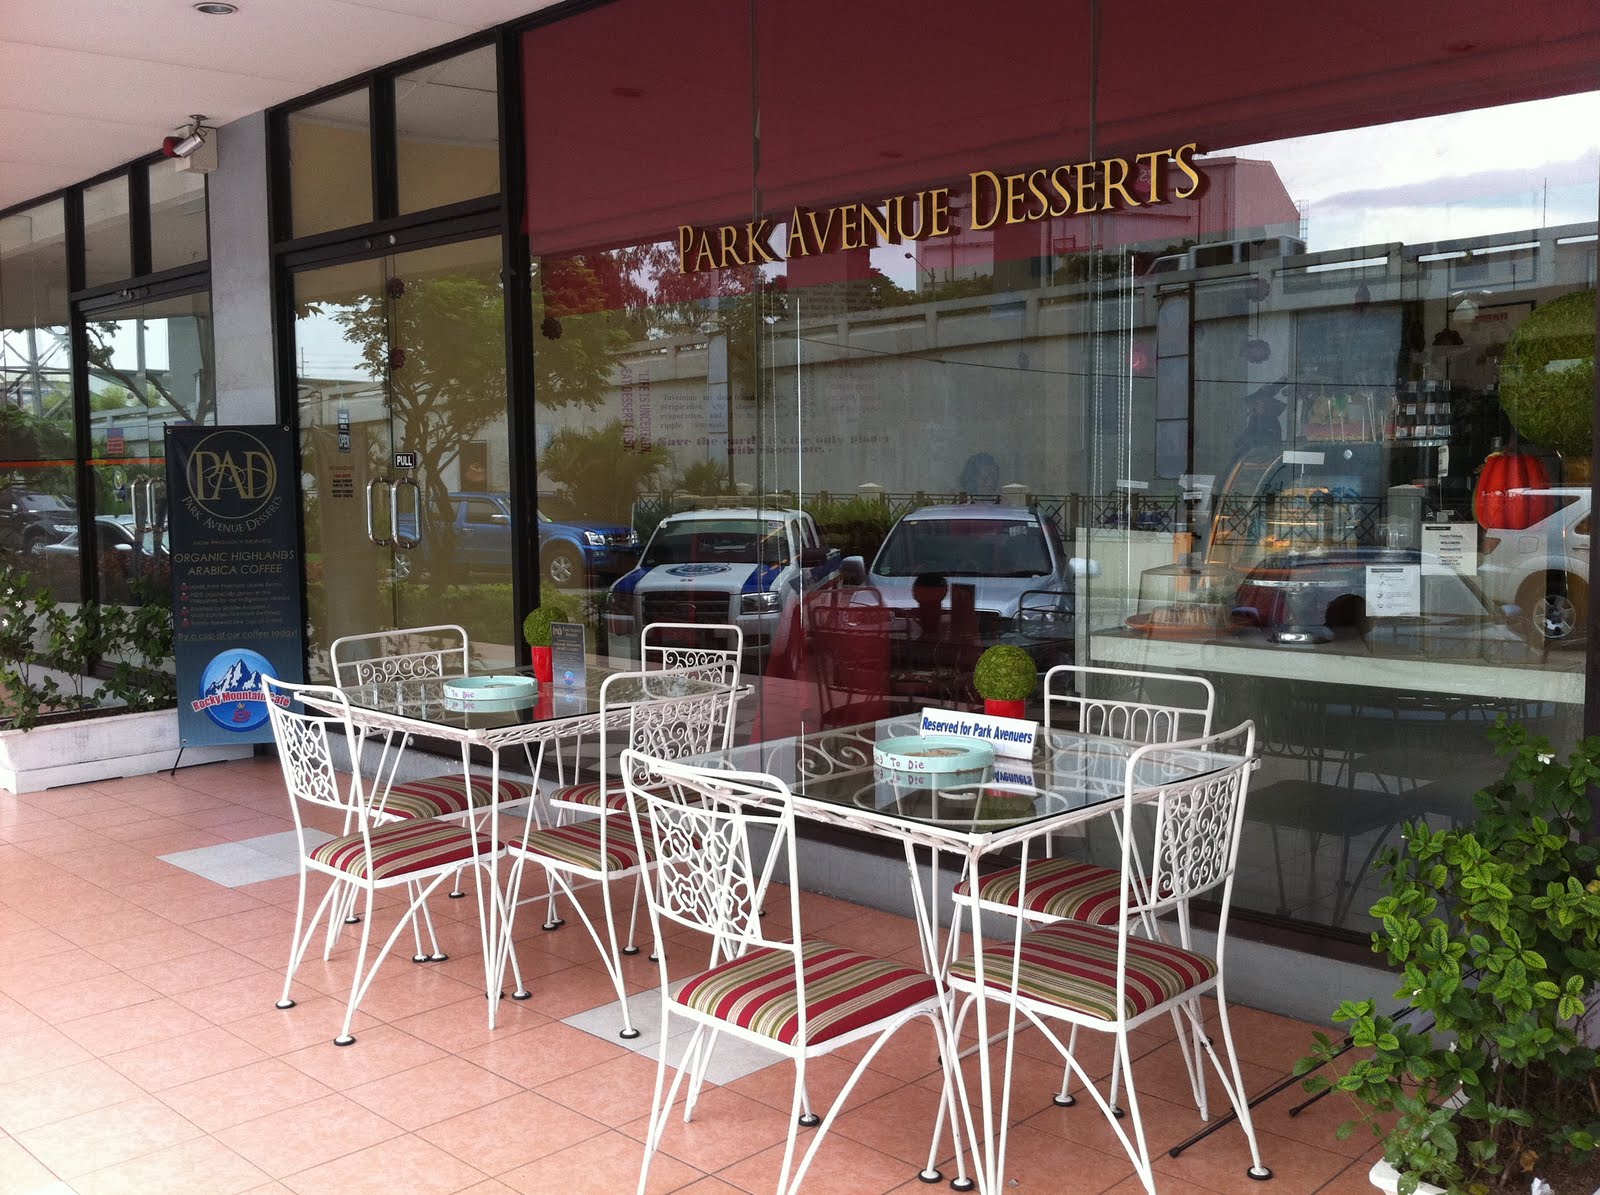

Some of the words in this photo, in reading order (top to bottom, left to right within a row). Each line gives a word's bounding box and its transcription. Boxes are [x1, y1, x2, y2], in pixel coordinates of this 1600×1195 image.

[677, 219, 774, 274] PARK
[786, 187, 950, 257] AVENUE
[969, 142, 1200, 231] DESSERTS
[338, 433, 350, 448] OPEN
[396, 455, 413, 467] PULL
[192, 449, 273, 501] PAD
[181, 495, 204, 521] PARK
[203, 516, 245, 533] AVENUE
[245, 495, 283, 532] DESSERTS
[173, 552, 228, 563] ORGANIC
[231, 550, 295, 561] HIGHLANDS
[187, 565, 237, 576] ARABICA
[241, 563, 283, 575] COFFEE
[178, 632, 190, 641] Try
[198, 632, 215, 641] cup
[216, 632, 226, 640] of
[242, 630, 270, 638] coffee
[191, 692, 222, 713] Rocky
[221, 689, 266, 702] Mountain
[922, 716, 959, 735] Reserved
[959, 723, 973, 736] for
[973, 722, 993, 739] Park
[993, 726, 1034, 744] Avenuers
[890, 757, 901, 768] To
[908, 760, 926, 770] Die
